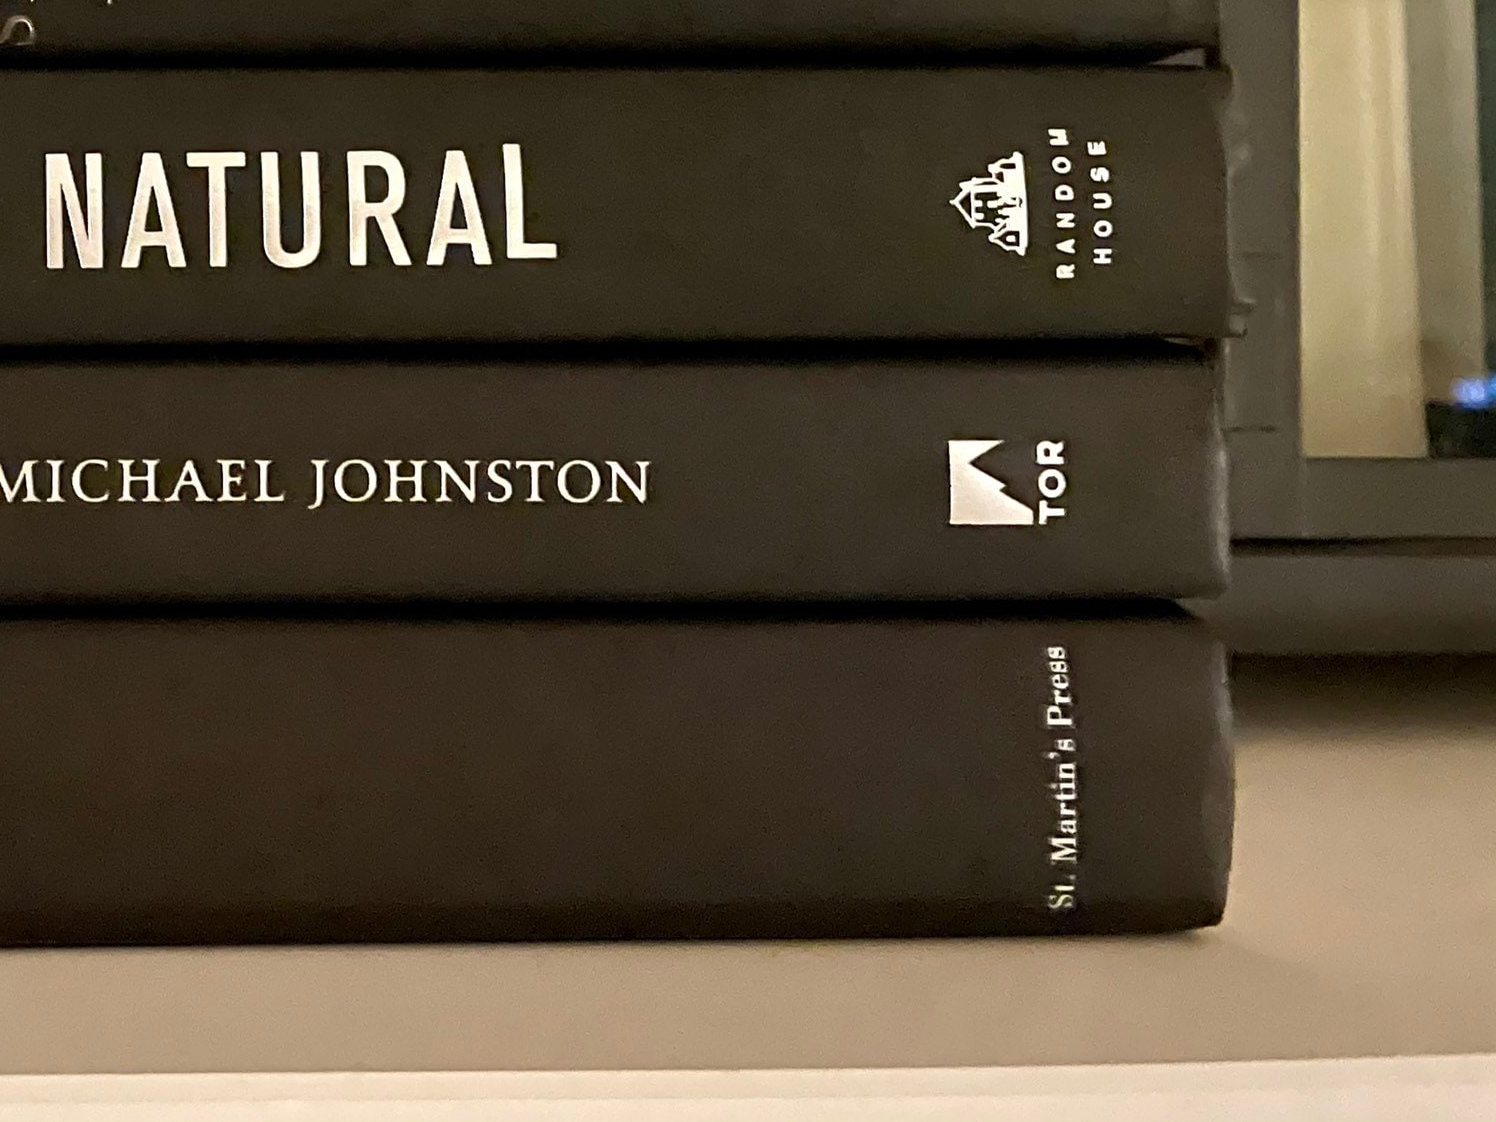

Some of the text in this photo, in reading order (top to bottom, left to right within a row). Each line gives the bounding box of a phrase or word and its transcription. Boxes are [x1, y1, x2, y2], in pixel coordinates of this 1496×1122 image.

[44, 143, 558, 270] NATURAL
[1047, 128, 1076, 280] RANDOM
[1087, 140, 1114, 265] HOUSE
[307, 458, 652, 510] JOHNSTON
[1036, 440, 1067, 525] TOR
[1046, 646, 1074, 727] Press
[1046, 738, 1078, 865] Martin's
